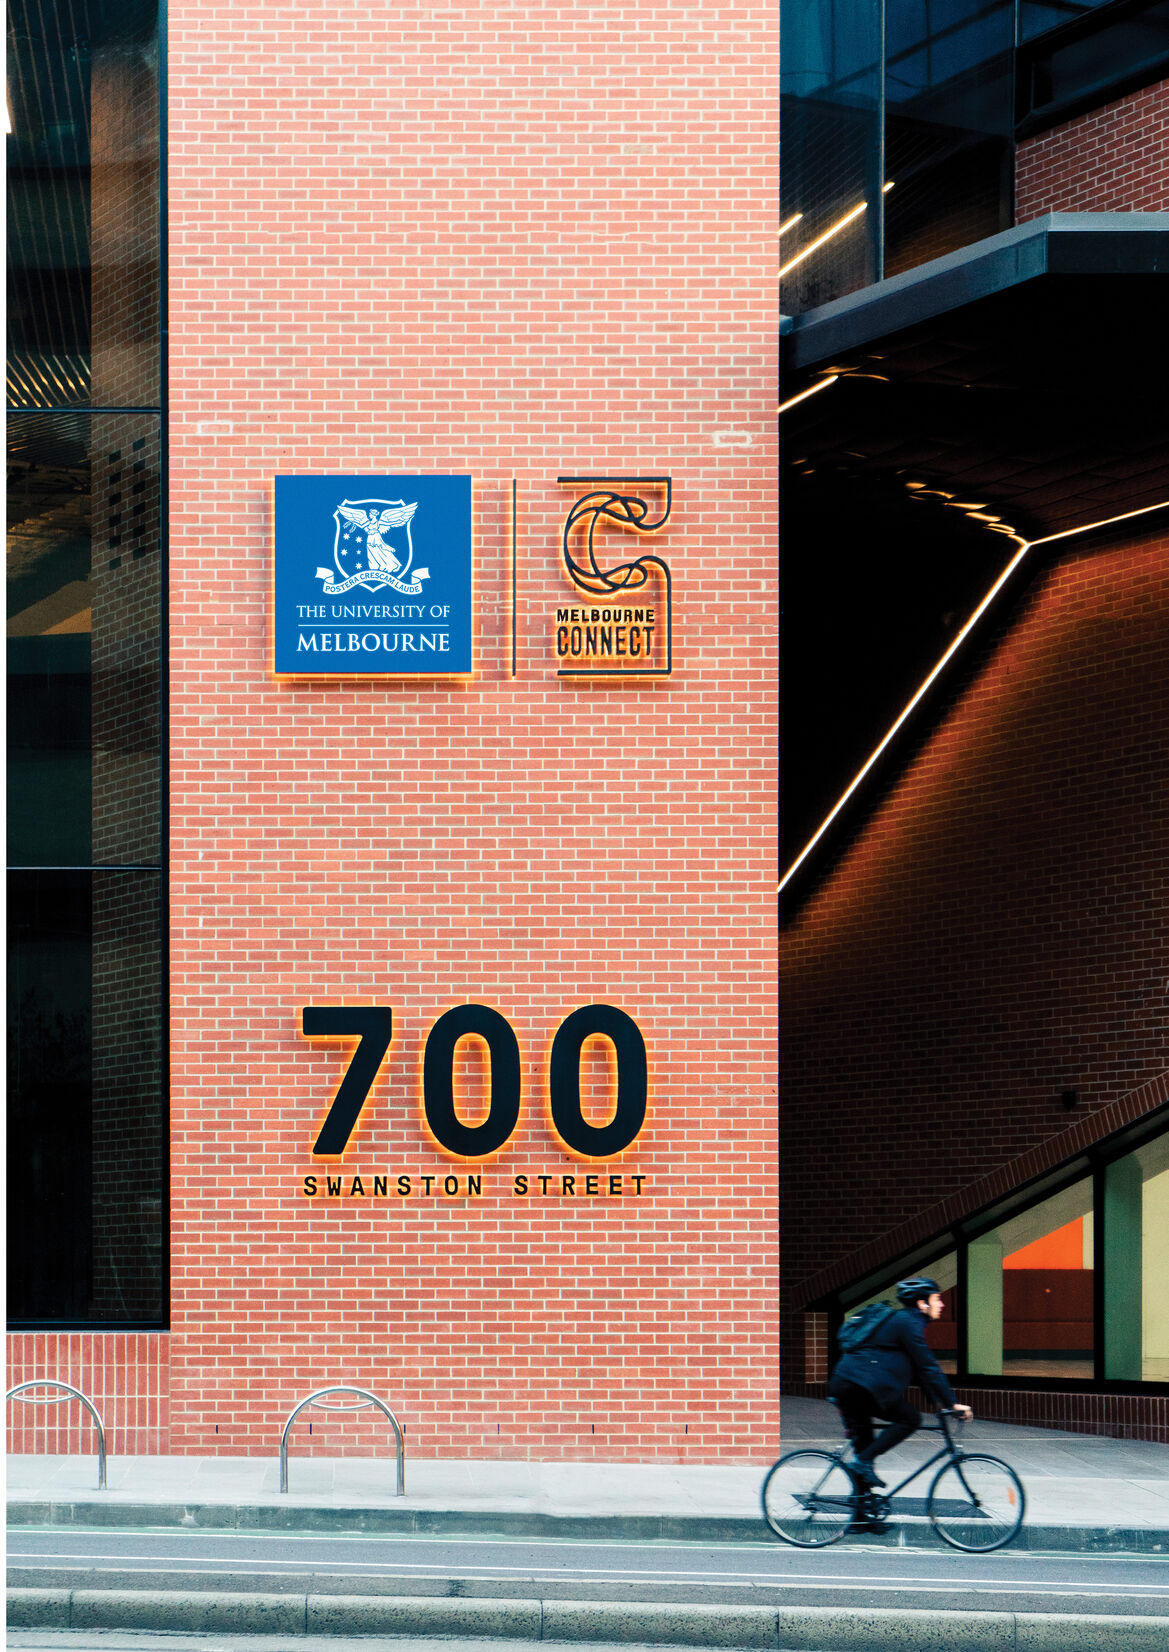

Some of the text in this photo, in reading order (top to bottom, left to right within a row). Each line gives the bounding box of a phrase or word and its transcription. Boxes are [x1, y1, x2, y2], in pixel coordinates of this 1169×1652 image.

[325, 572, 420, 593] POSTERA CRESCAM LAUDE
[296, 605, 450, 618] THE UNIVERSITY OF
[557, 608, 655, 623] MELBOURNE
[296, 633, 450, 652] MELBOURNE
[557, 625, 655, 656] CONNECT
[302, 1003, 648, 1157] 700
[303, 1175, 647, 1196] SWANSTON STREET
